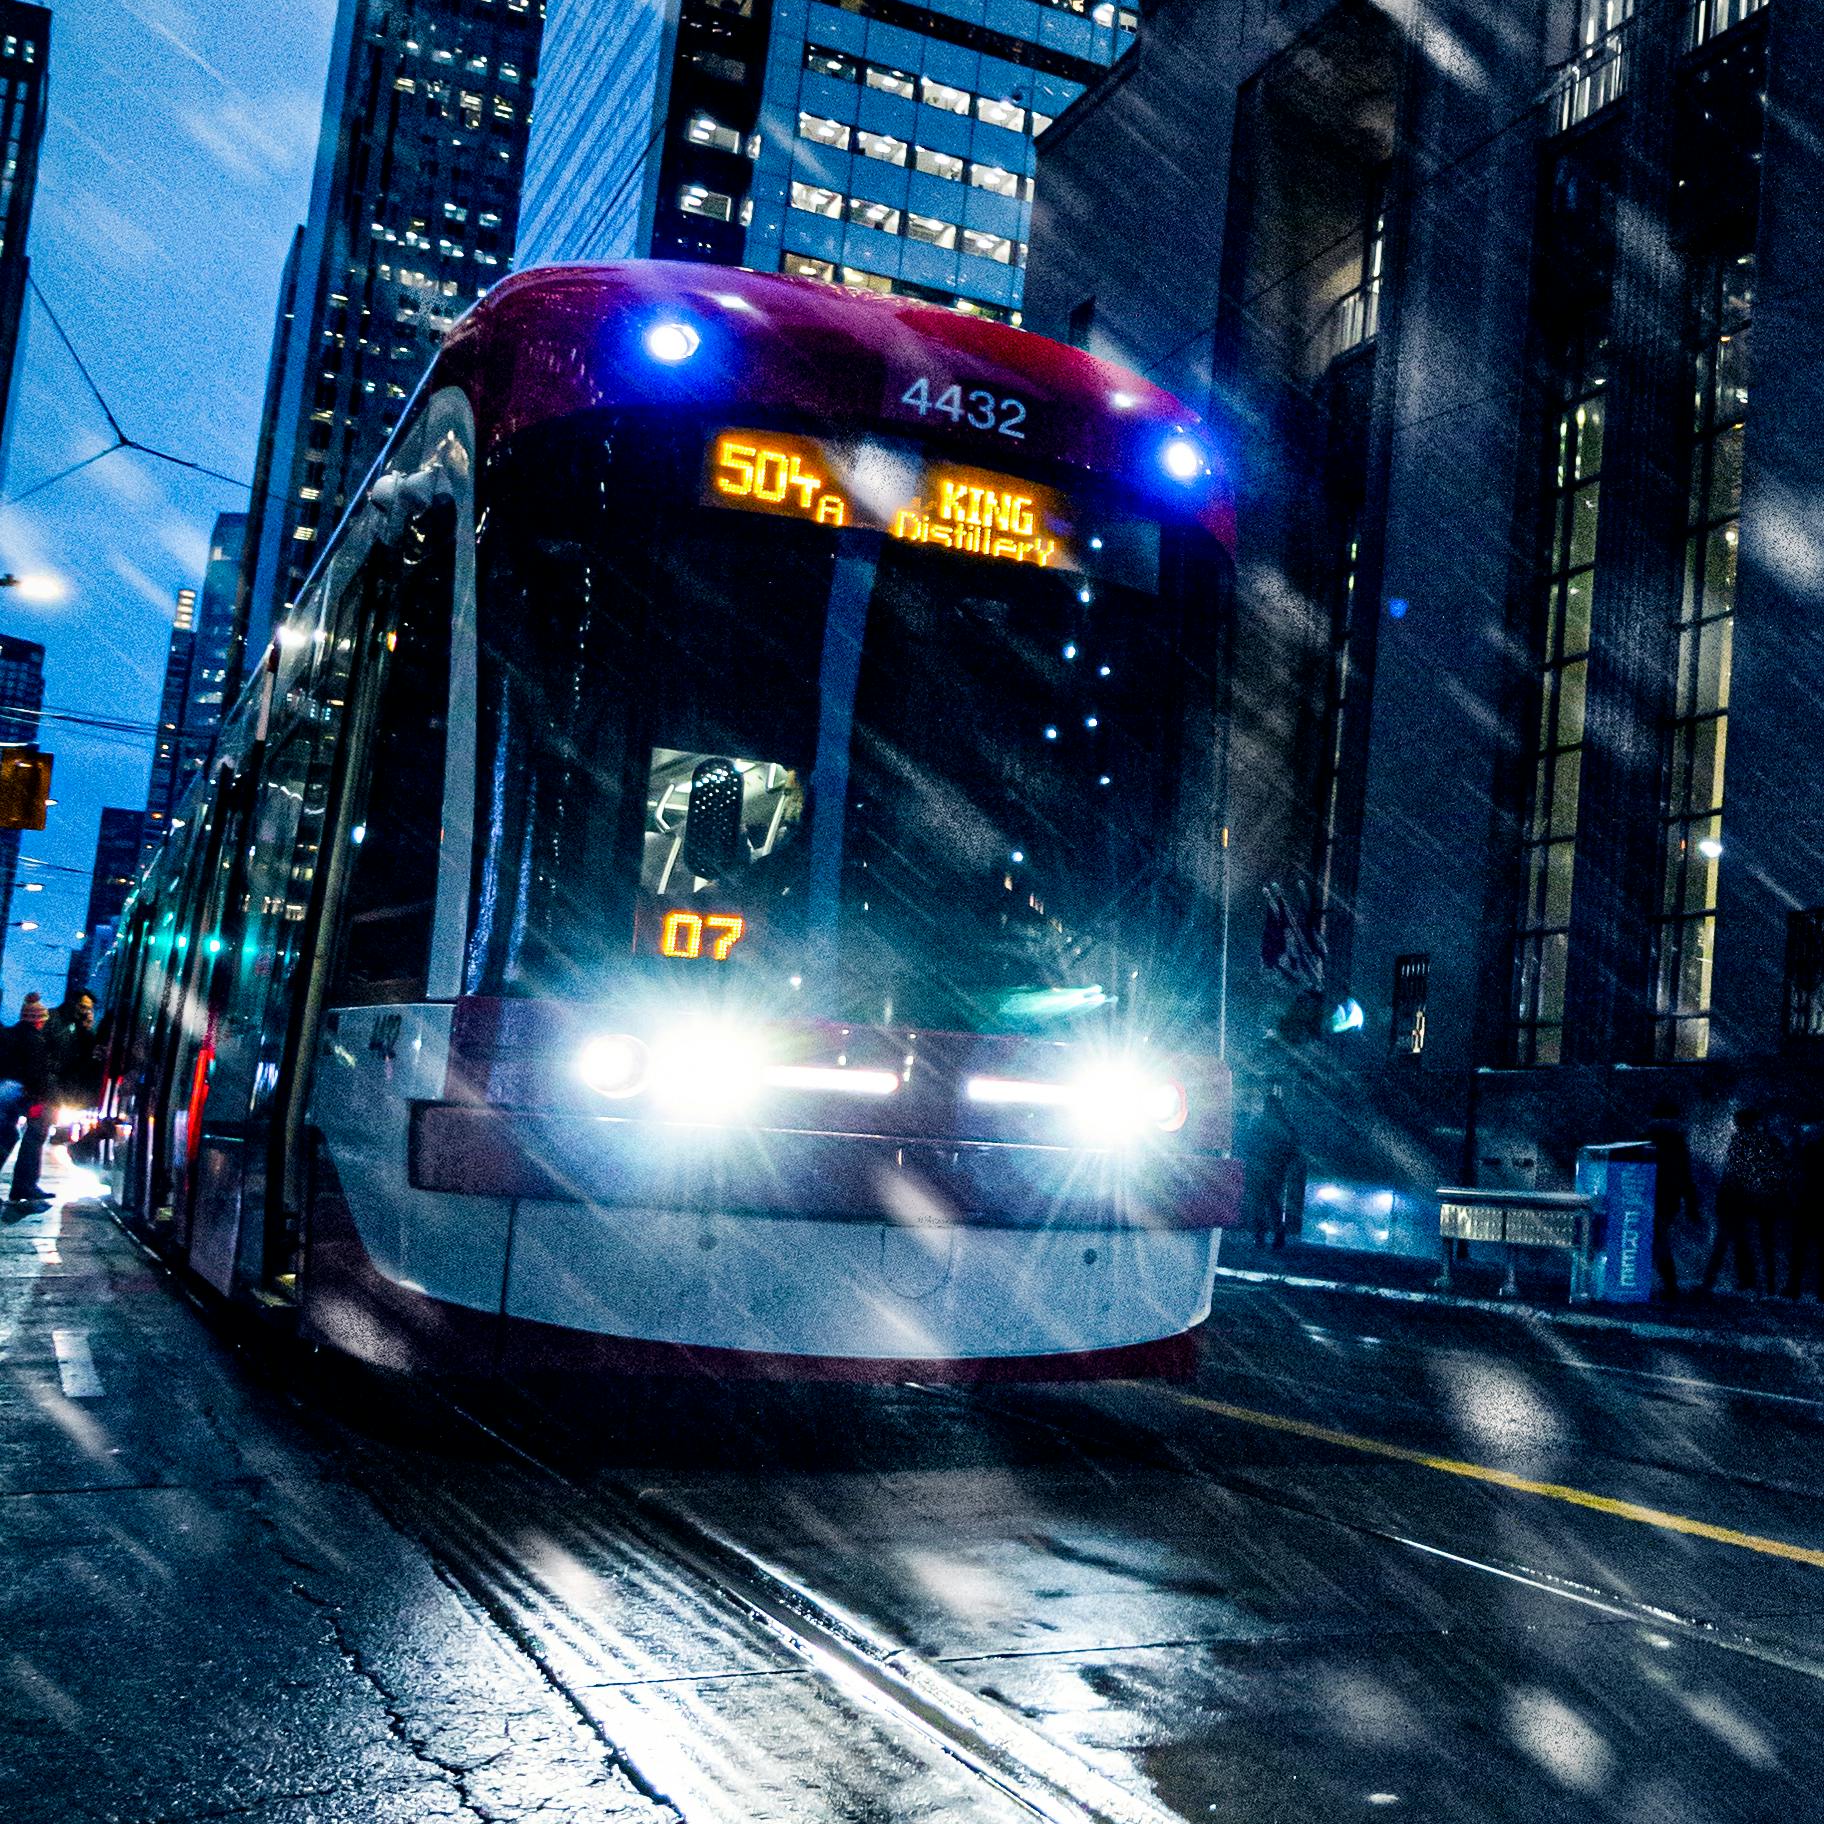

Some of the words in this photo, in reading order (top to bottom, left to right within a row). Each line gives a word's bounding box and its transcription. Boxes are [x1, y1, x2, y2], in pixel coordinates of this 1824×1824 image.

[901, 377, 1027, 440] 4432
[939, 478, 1035, 537] KING
[661, 911, 745, 961] 07
